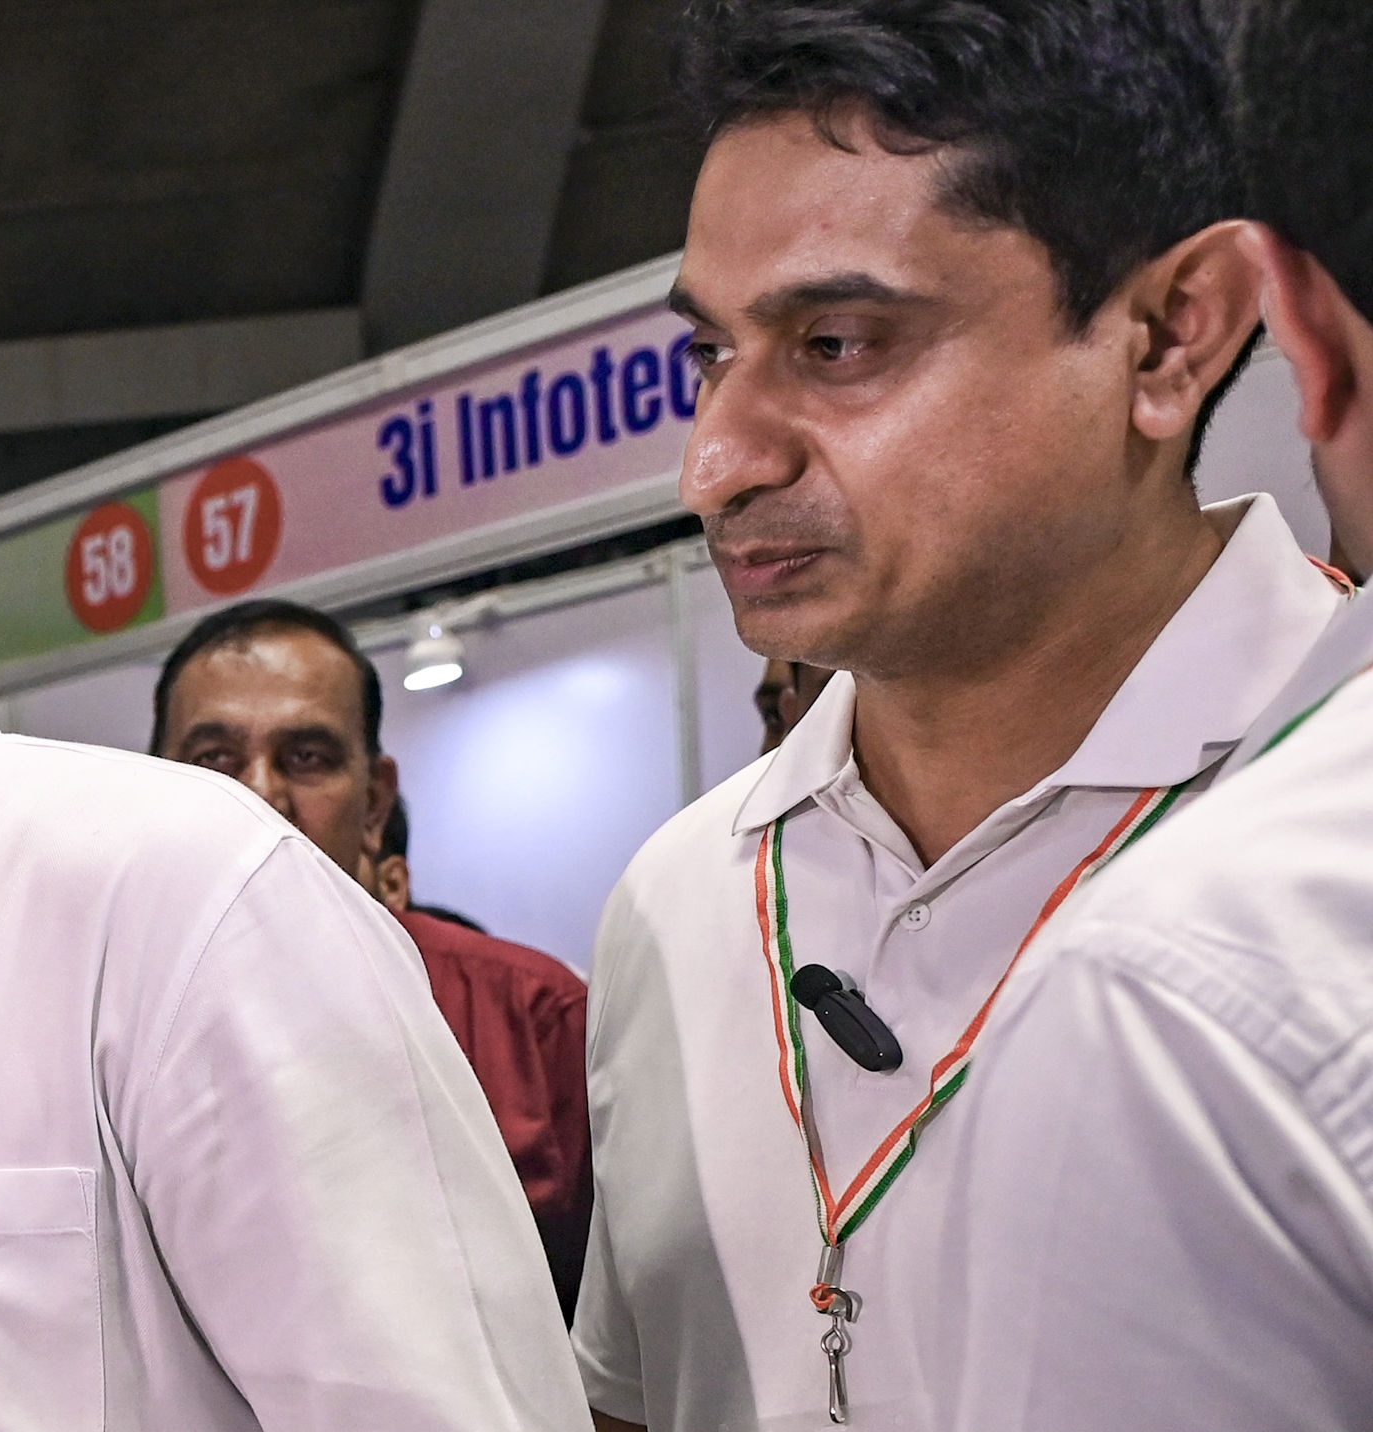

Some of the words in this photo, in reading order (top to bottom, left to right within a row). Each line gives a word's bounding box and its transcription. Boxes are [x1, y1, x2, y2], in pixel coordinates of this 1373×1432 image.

[377, 400, 439, 508] 3i
[80, 523, 136, 606] 58
[202, 484, 258, 570] 57
